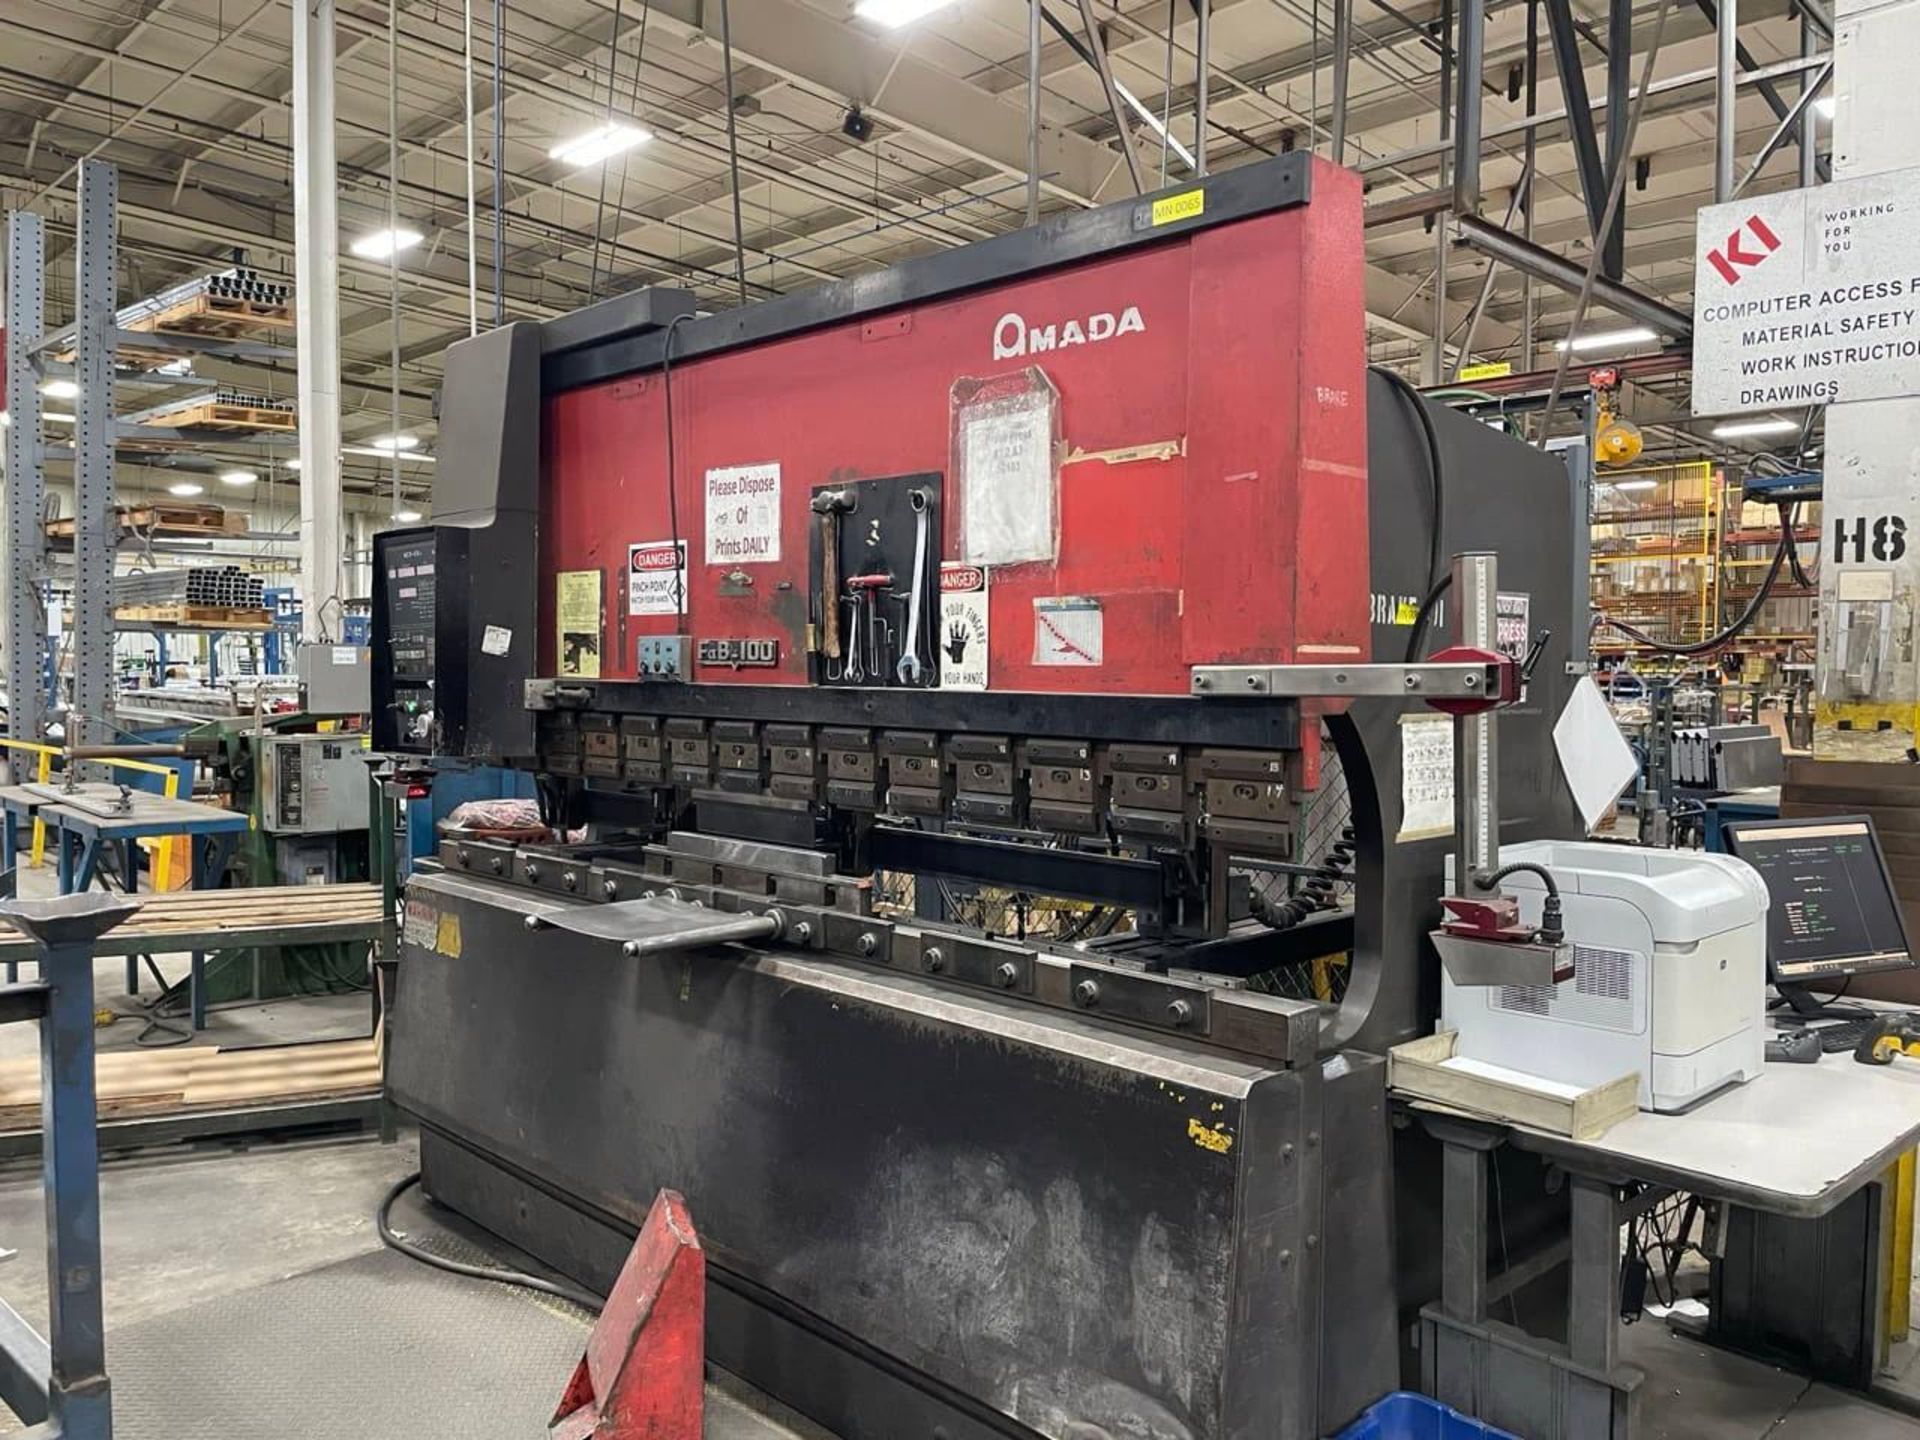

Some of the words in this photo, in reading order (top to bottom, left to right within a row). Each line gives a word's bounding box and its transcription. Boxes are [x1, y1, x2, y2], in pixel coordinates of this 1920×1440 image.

[1825, 203, 1894, 222] WORKING
[1824, 226, 1851, 238] FOR
[1706, 215, 1782, 286] KI
[1824, 241, 1851, 254] YOU
[1703, 294, 1812, 322] COMPUTER
[1819, 280, 1902, 305] ACCESS
[993, 307, 1145, 360] AMADA
[1742, 321, 1833, 346] MATERIAL
[1840, 310, 1915, 334] SAFETY
[1741, 355, 1796, 375] WORK
[1803, 340, 1920, 368] INSTRUCTIO
[1741, 380, 1839, 404] DRAWINGS
[709, 479, 737, 496] Please
[739, 475, 775, 498] Dispose
[736, 505, 748, 524] Of
[715, 538, 741, 555] Prints
[743, 536, 770, 554] DAILY
[1834, 515, 1907, 563] H8
[638, 551, 676, 566] DANGER
[944, 672, 961, 685] YOUR
